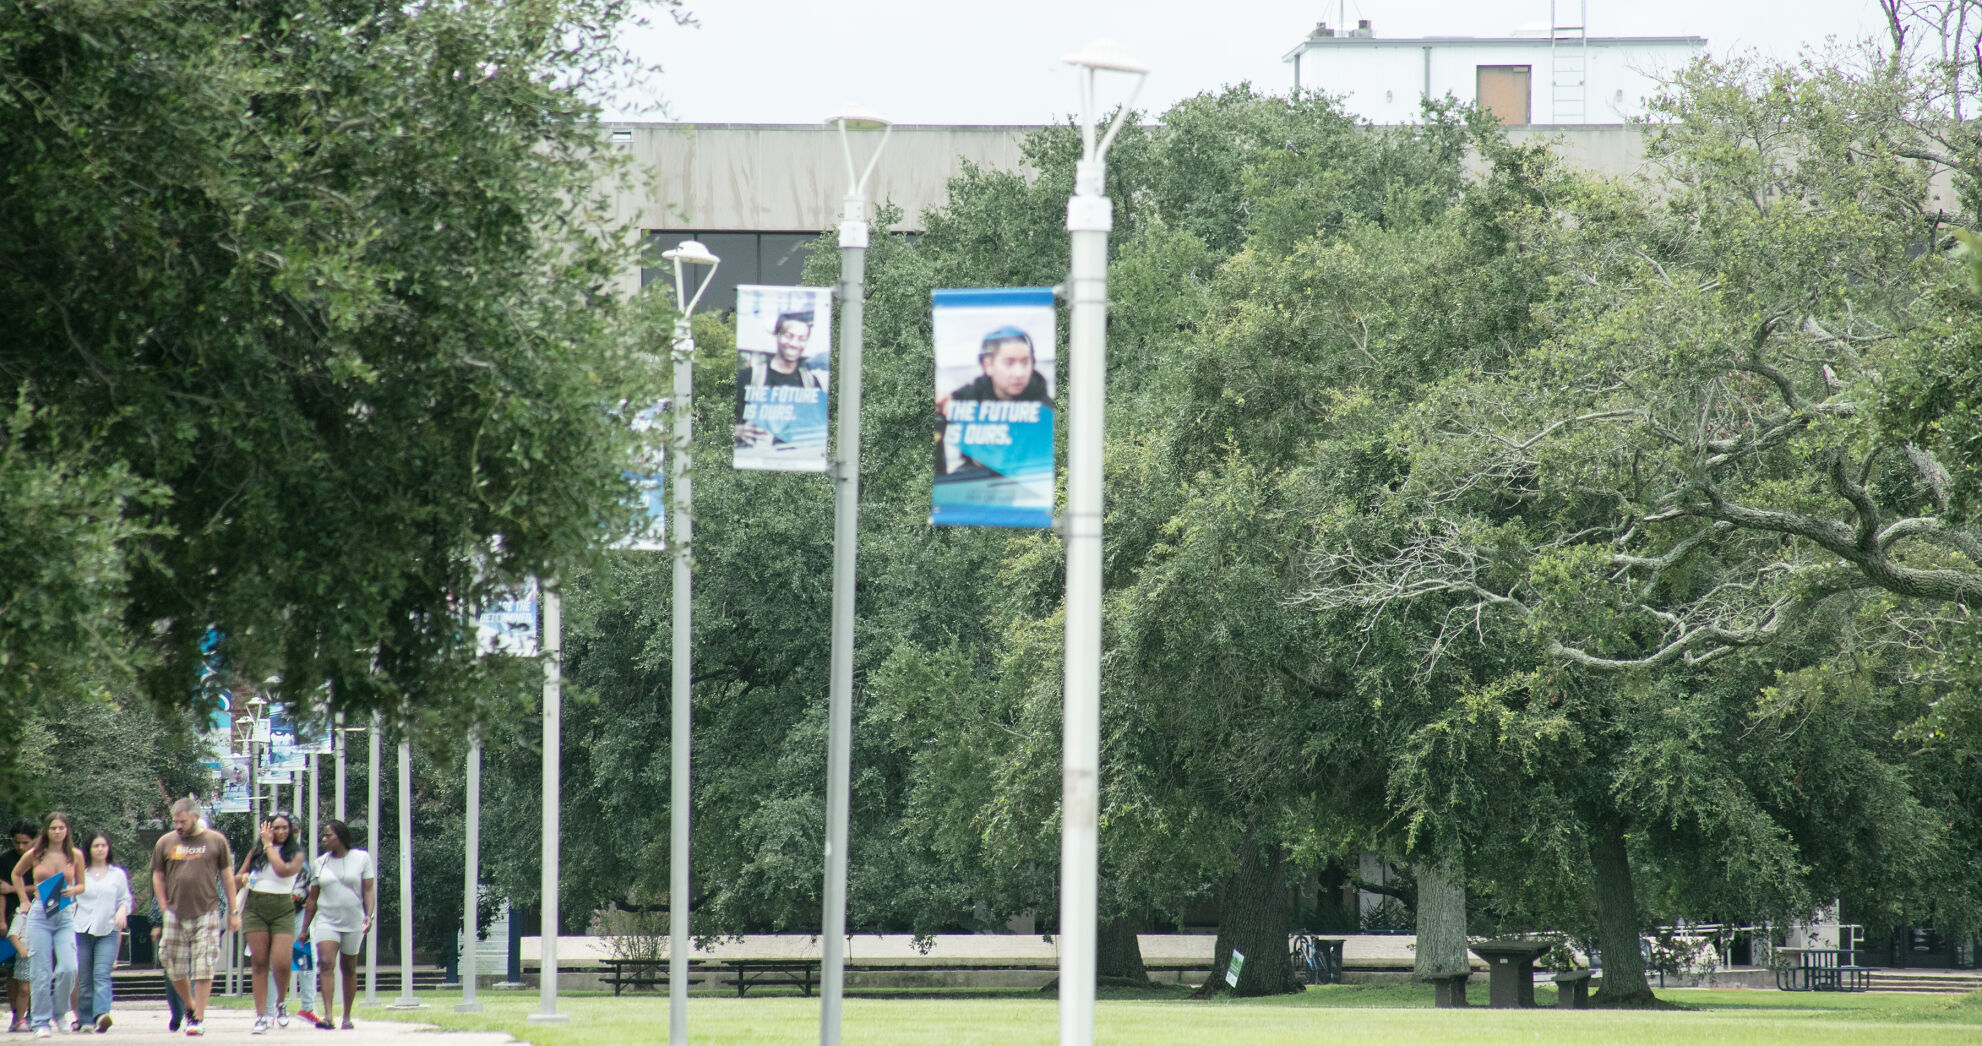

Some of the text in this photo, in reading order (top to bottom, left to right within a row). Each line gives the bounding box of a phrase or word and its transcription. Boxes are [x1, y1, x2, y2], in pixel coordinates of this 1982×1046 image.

[744, 385, 820, 403] THE FUTURE
[743, 404, 797, 421] IS OURS.
[946, 401, 1041, 423] THE FUTURE
[945, 423, 1013, 445] IS OURS.
[176, 845, 206, 854] Biloxi
